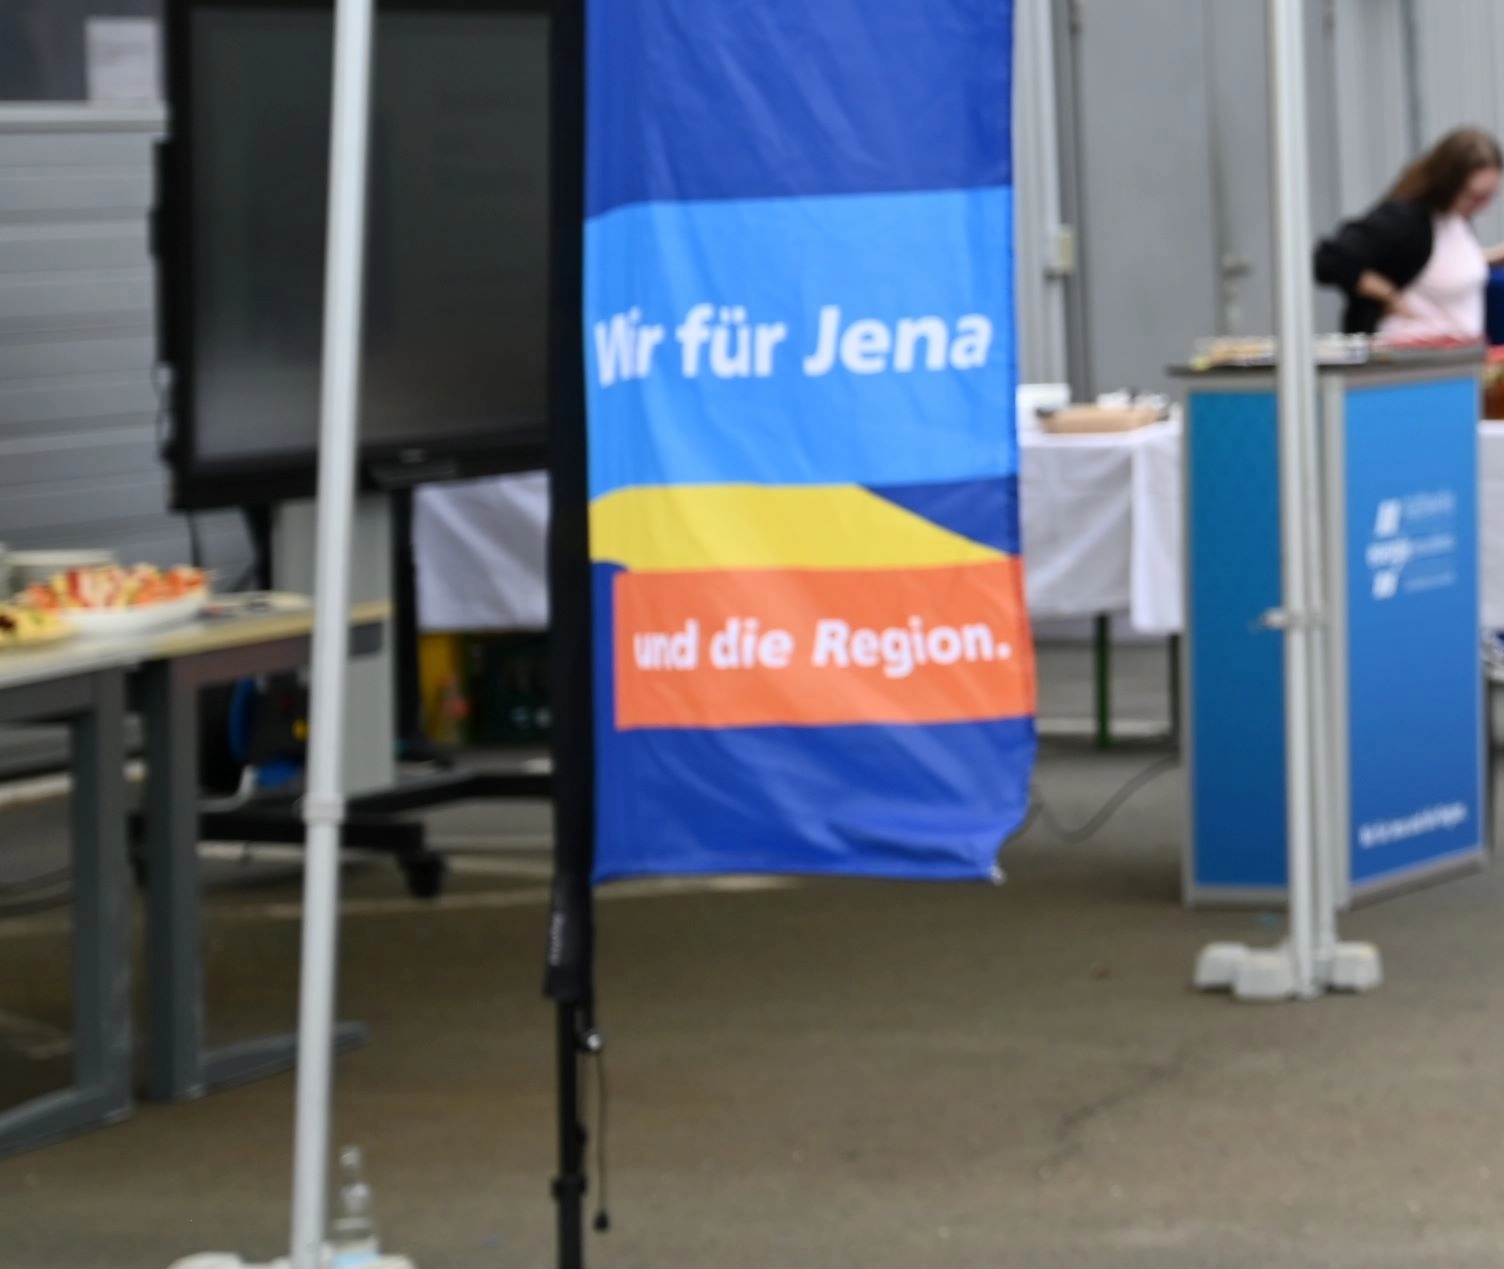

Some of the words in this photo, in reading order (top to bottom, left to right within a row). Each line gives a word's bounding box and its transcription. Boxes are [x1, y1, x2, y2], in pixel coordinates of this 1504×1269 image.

[594, 306, 665, 387] Wir
[676, 303, 787, 379] für
[803, 304, 993, 377] Jena
[633, 619, 698, 671] und
[710, 617, 794, 668] die
[812, 616, 1012, 679] Region.
